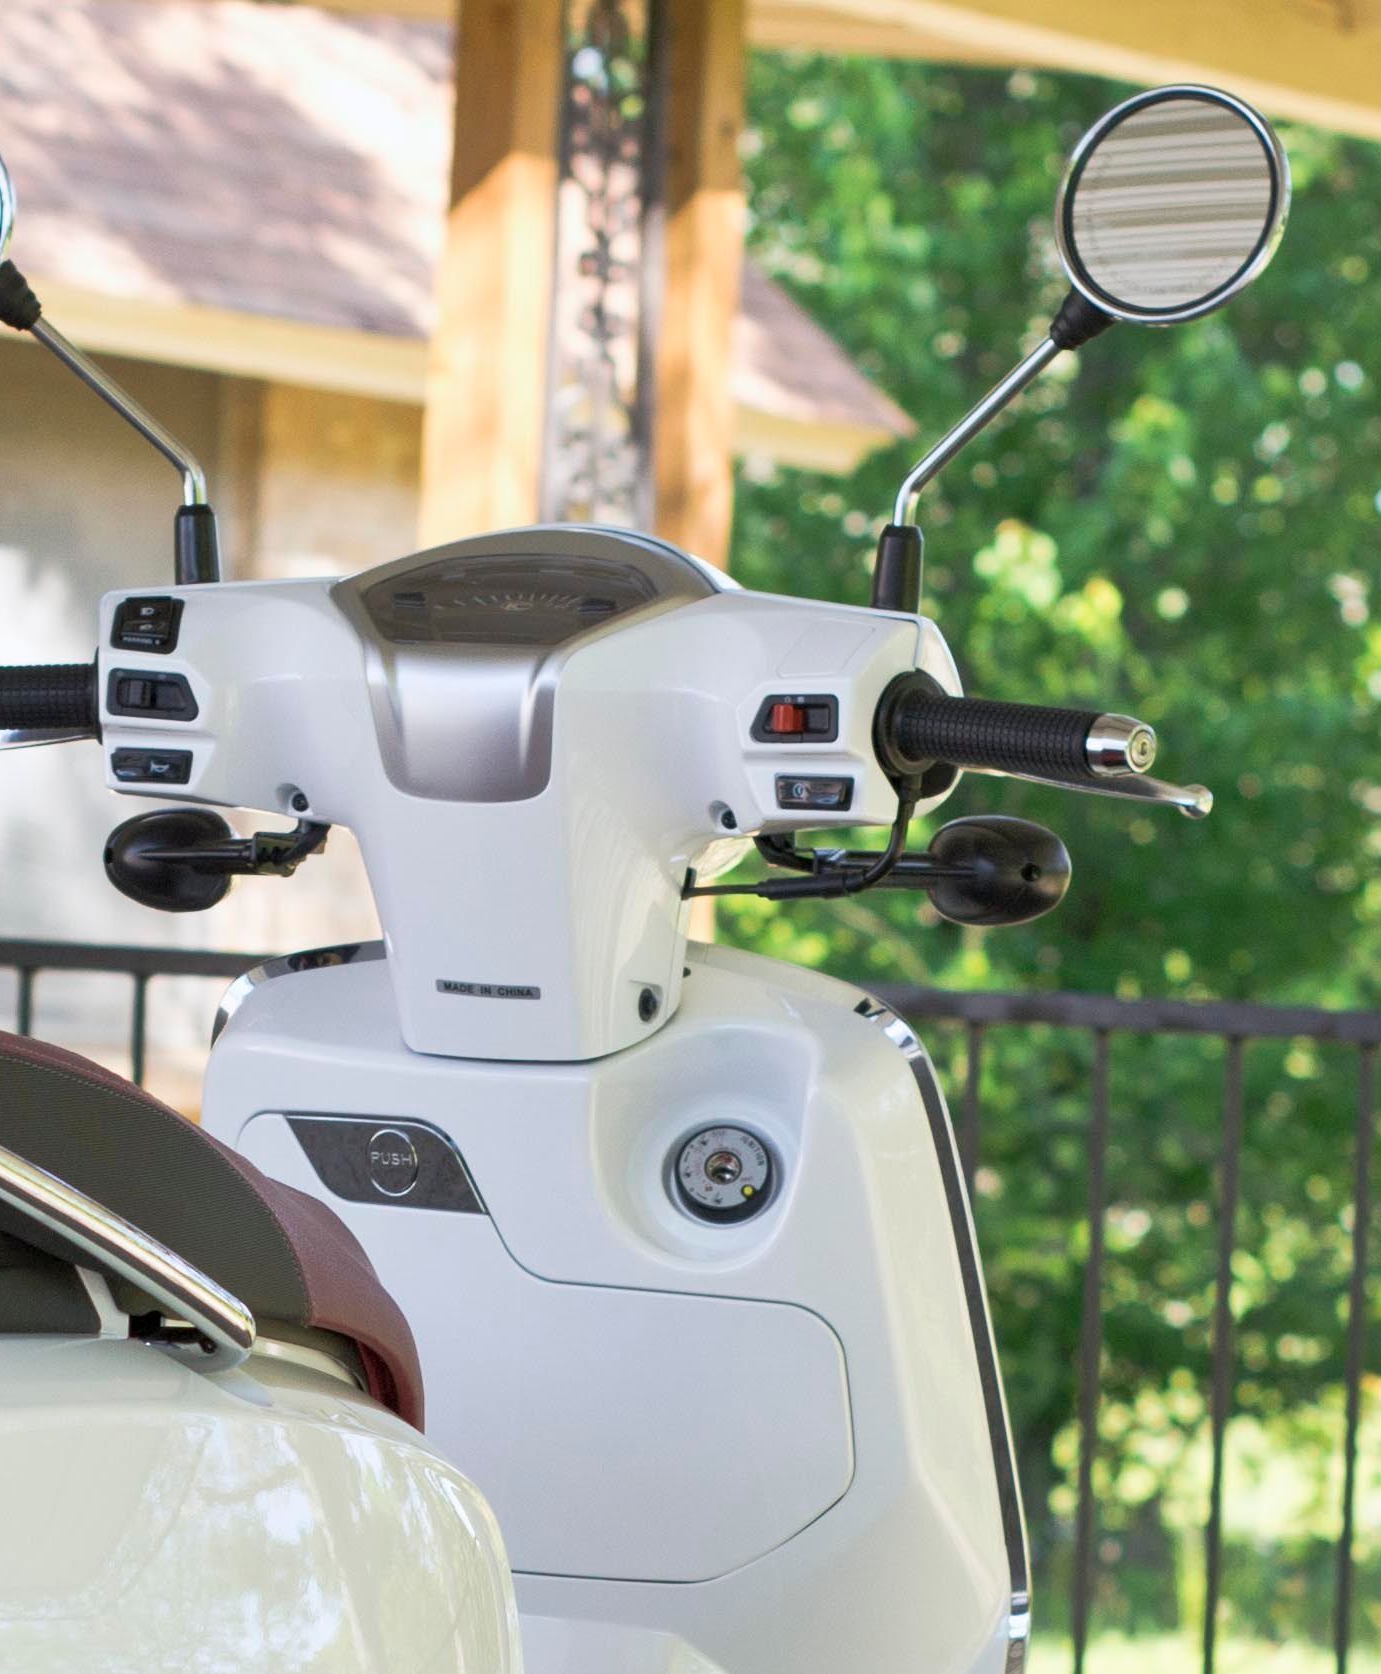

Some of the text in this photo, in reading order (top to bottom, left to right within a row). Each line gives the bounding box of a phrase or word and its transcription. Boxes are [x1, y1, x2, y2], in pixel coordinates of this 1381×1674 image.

[443, 981, 534, 998] MADE IN CHINA
[370, 1151, 413, 1166] PUSH
